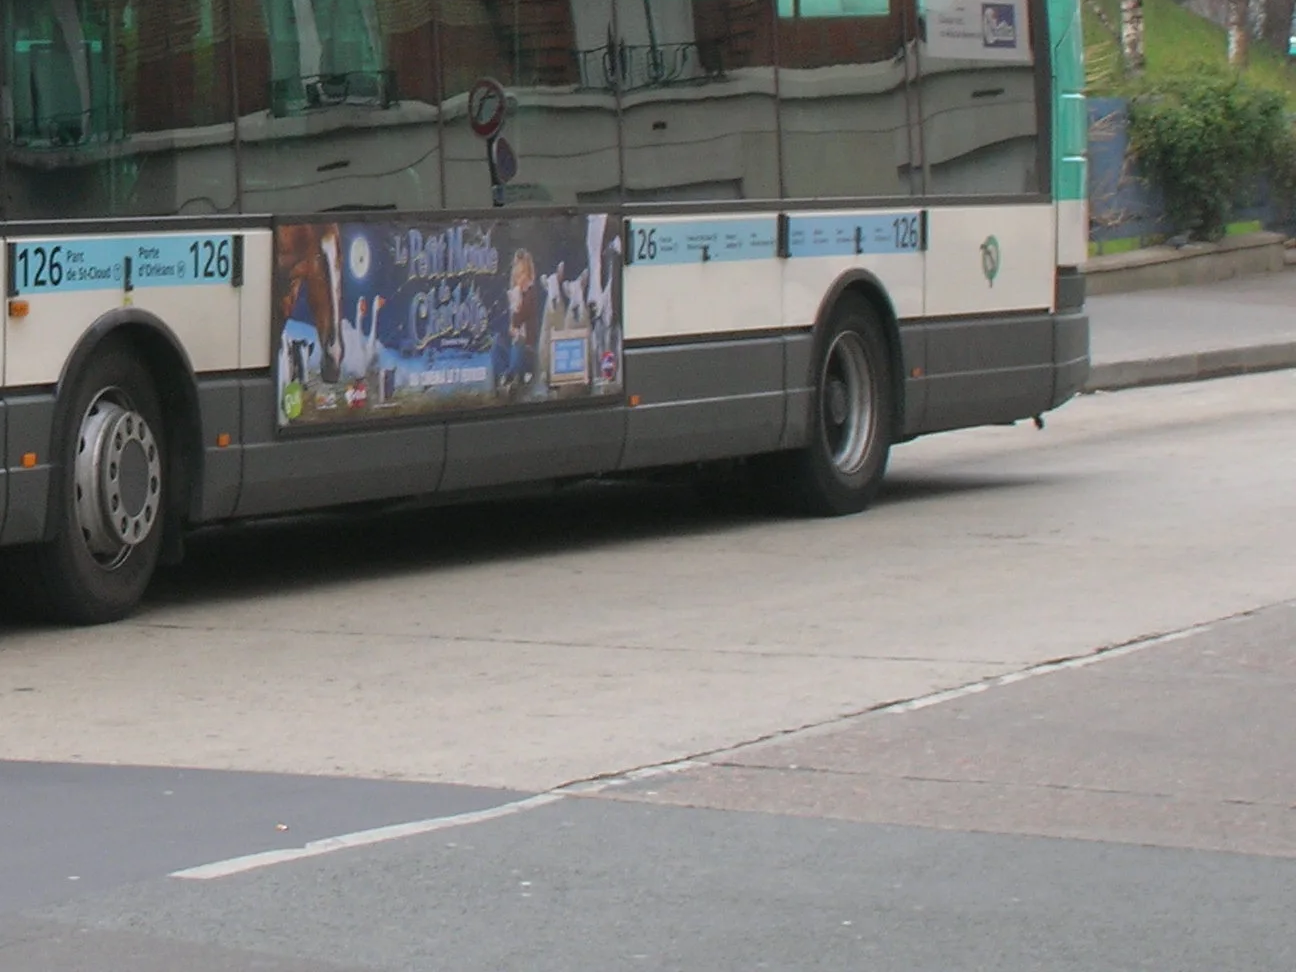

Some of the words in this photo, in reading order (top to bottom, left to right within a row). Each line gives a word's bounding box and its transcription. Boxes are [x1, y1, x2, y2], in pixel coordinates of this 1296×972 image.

[637, 229, 657, 260] 26
[893, 215, 918, 249] 126
[18, 245, 63, 288] 126
[66, 250, 84, 263] Parc
[189, 239, 230, 279] 126
